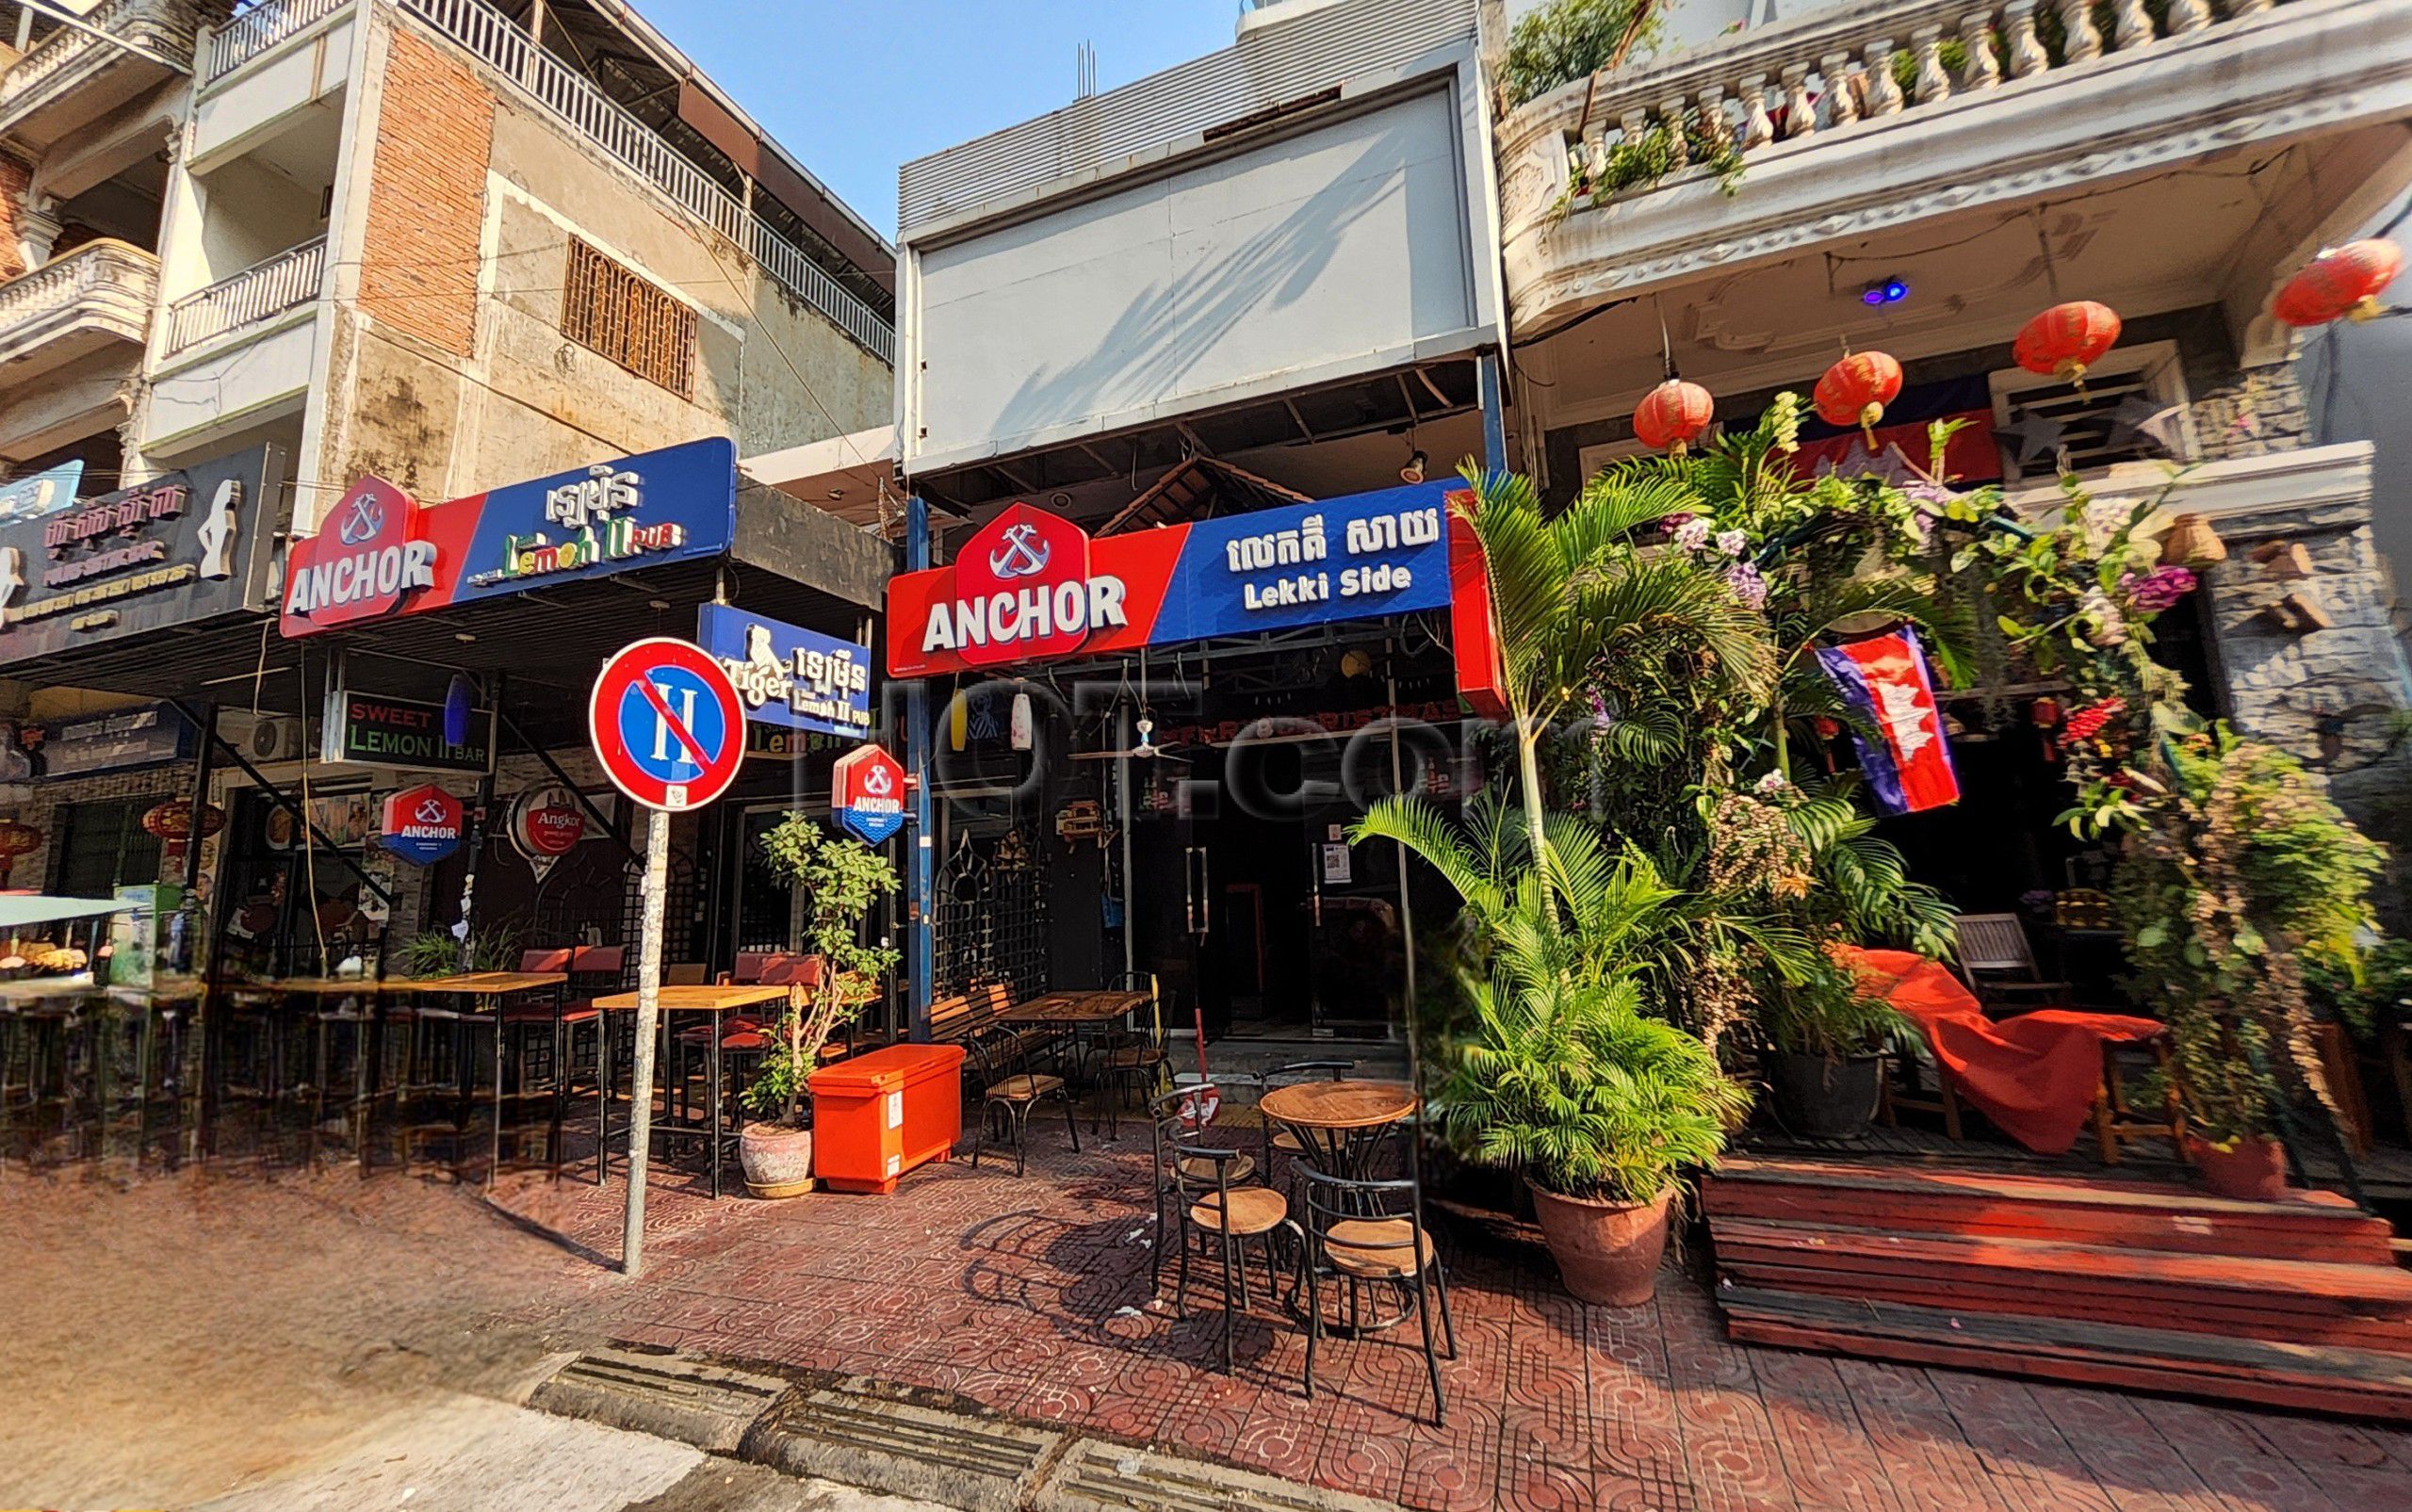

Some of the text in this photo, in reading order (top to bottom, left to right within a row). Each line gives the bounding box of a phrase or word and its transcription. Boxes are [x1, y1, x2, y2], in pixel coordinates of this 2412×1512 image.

[285, 541, 437, 615] ANCHOR
[1244, 564, 1411, 610] Lekki Side
[921, 575, 1127, 652] ANCHOR
[724, 658, 794, 707] Tiger
[350, 703, 432, 728] SWEET
[350, 723, 433, 757] LEMON
[454, 746, 485, 763] BAR
[537, 813, 580, 829] Angkor
[854, 796, 900, 814] ANCHOR
[401, 825, 456, 839] ANCHOR
